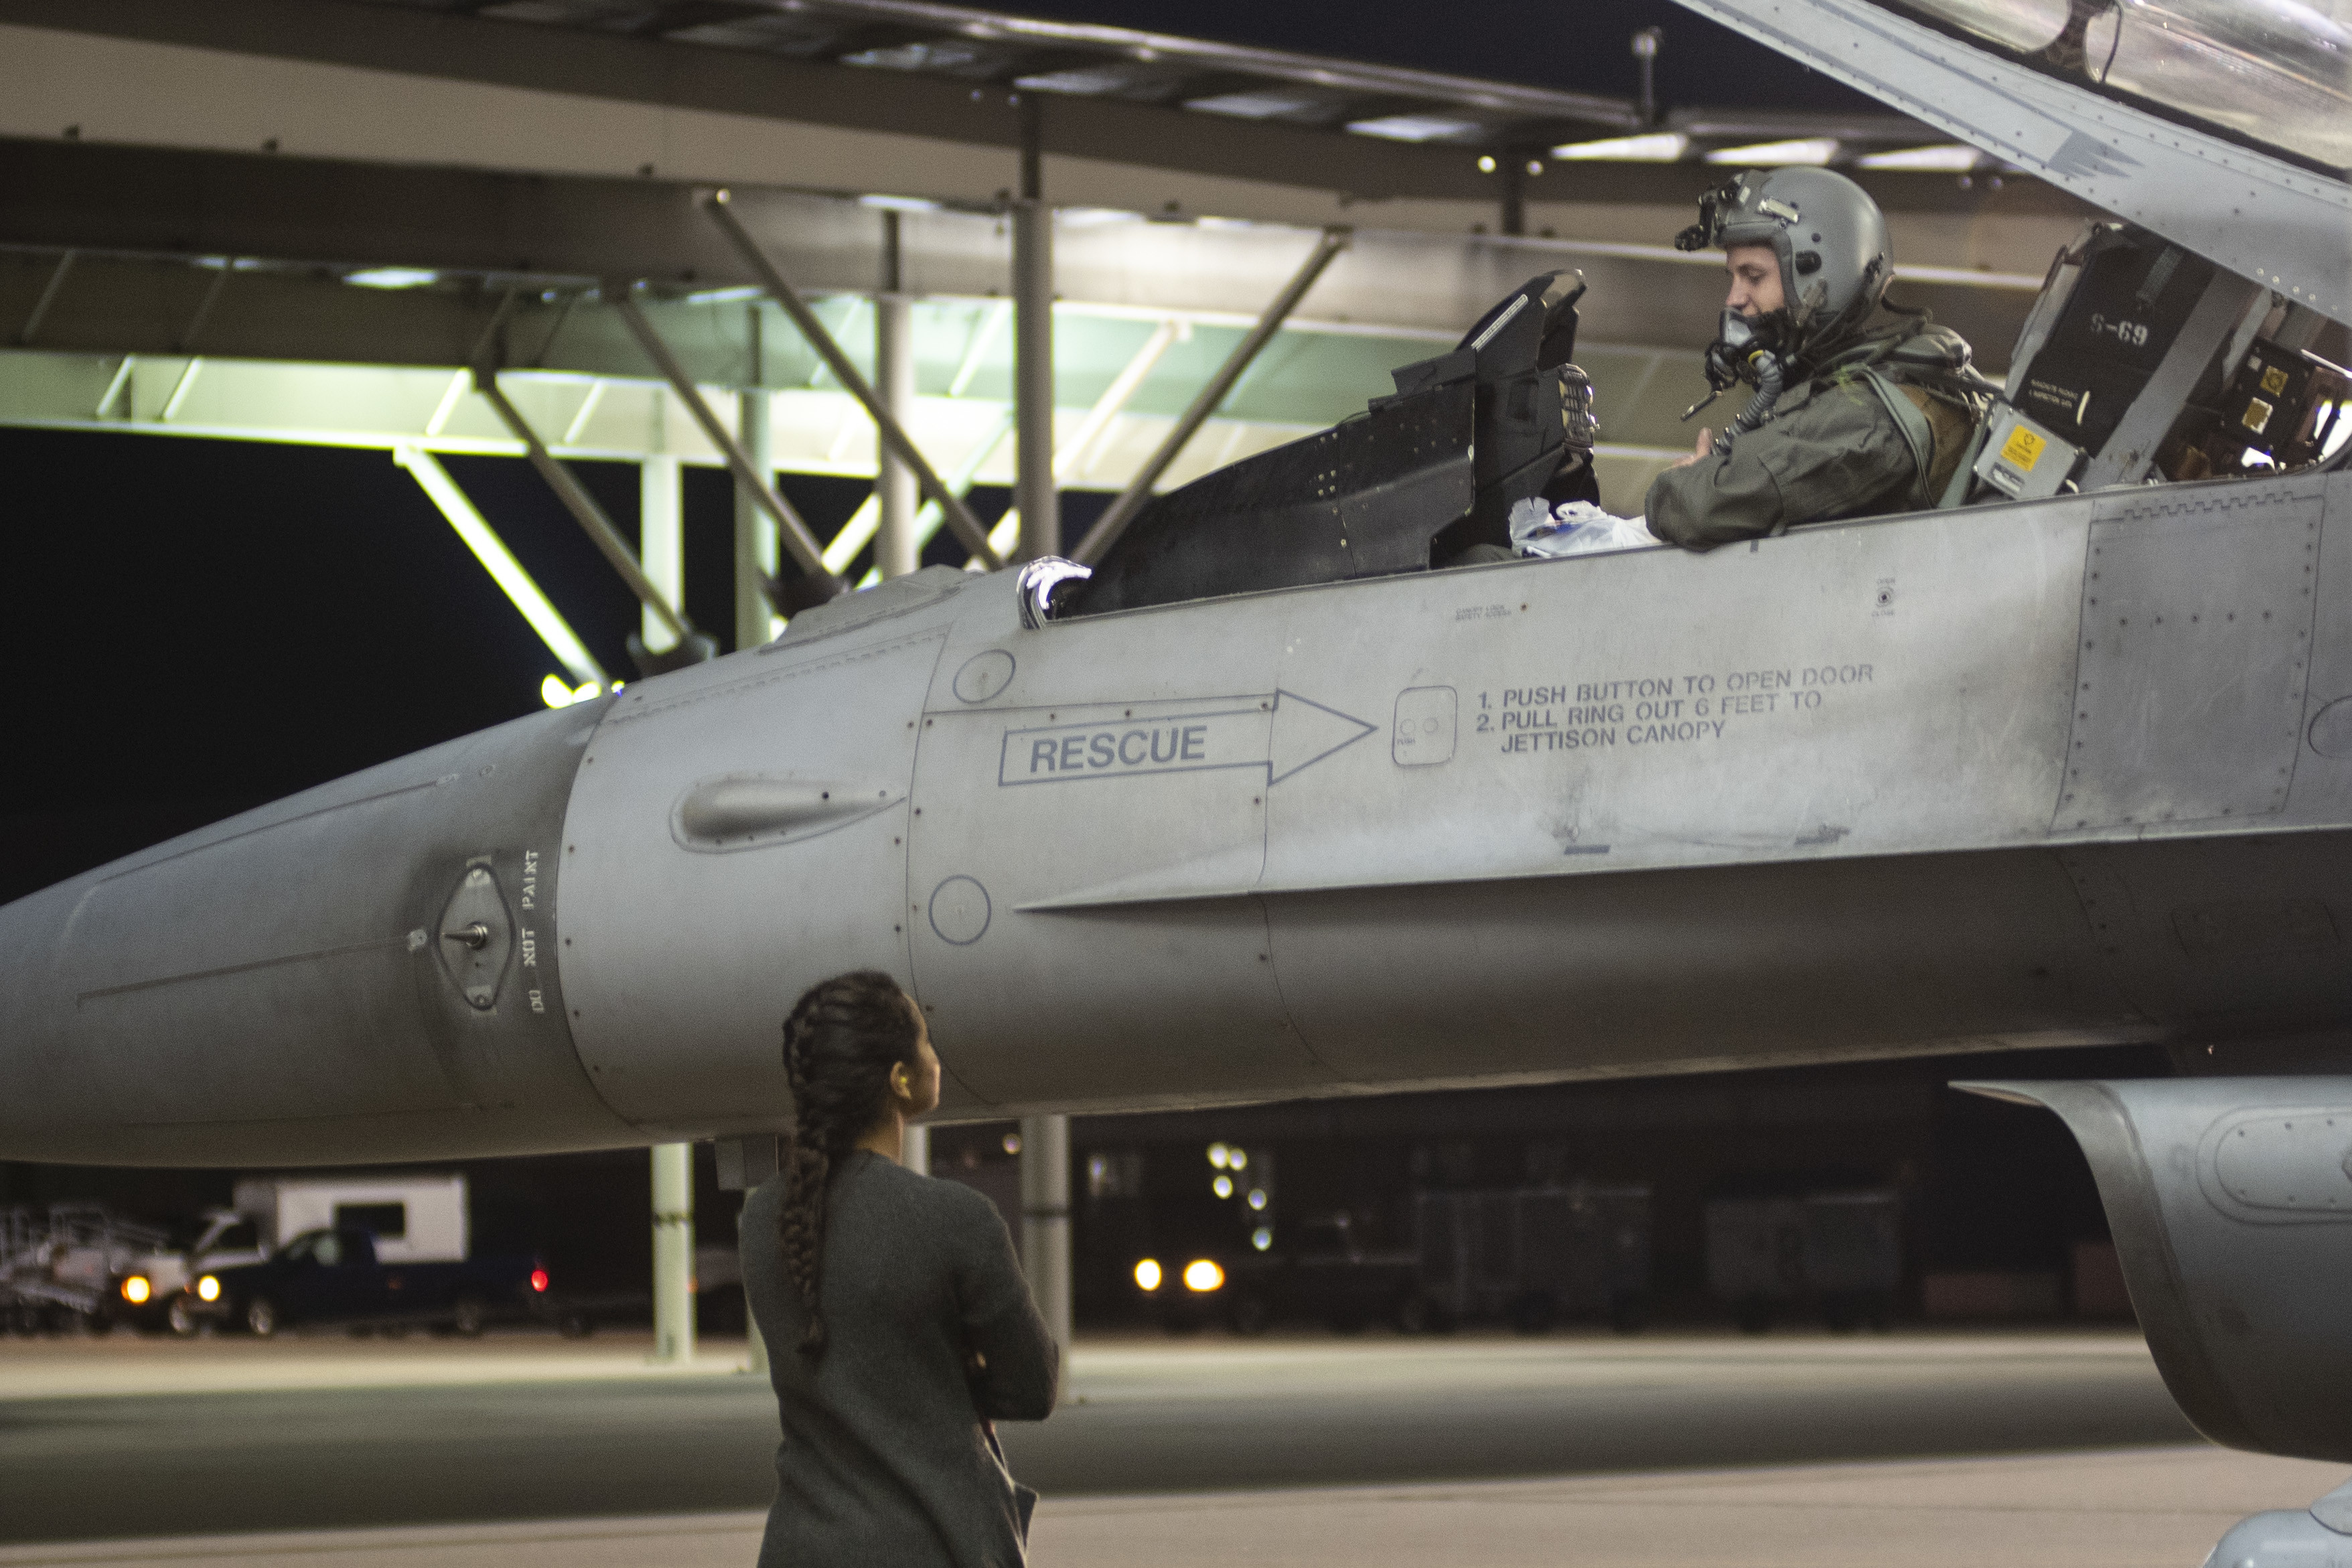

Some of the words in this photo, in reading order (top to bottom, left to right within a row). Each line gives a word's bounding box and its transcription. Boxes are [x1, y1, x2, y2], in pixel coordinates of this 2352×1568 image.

[2090, 313, 2148, 346] S-69
[1477, 691, 1492, 709] 1.
[1503, 685, 1566, 708] PUSH
[1576, 678, 1673, 702] BUTTON
[1683, 674, 1715, 695] TO
[1726, 670, 1791, 692] OPEN
[1802, 663, 1873, 686] DOOR
[1476, 713, 1495, 732] 2.
[1501, 709, 1558, 730] PULL
[1568, 704, 1624, 725] RING
[1635, 699, 1684, 722] OUT
[1694, 697, 1709, 716] 6
[1721, 692, 1779, 715] FEET
[1790, 690, 1822, 710] TO
[1030, 725, 1207, 773] RESCUE
[1501, 727, 1615, 753] JETTISON
[1627, 720, 1725, 745] CANOPY
[522, 850, 538, 910] PAINT
[522, 928, 536, 967] NOT
[528, 990, 544, 1014] DO
